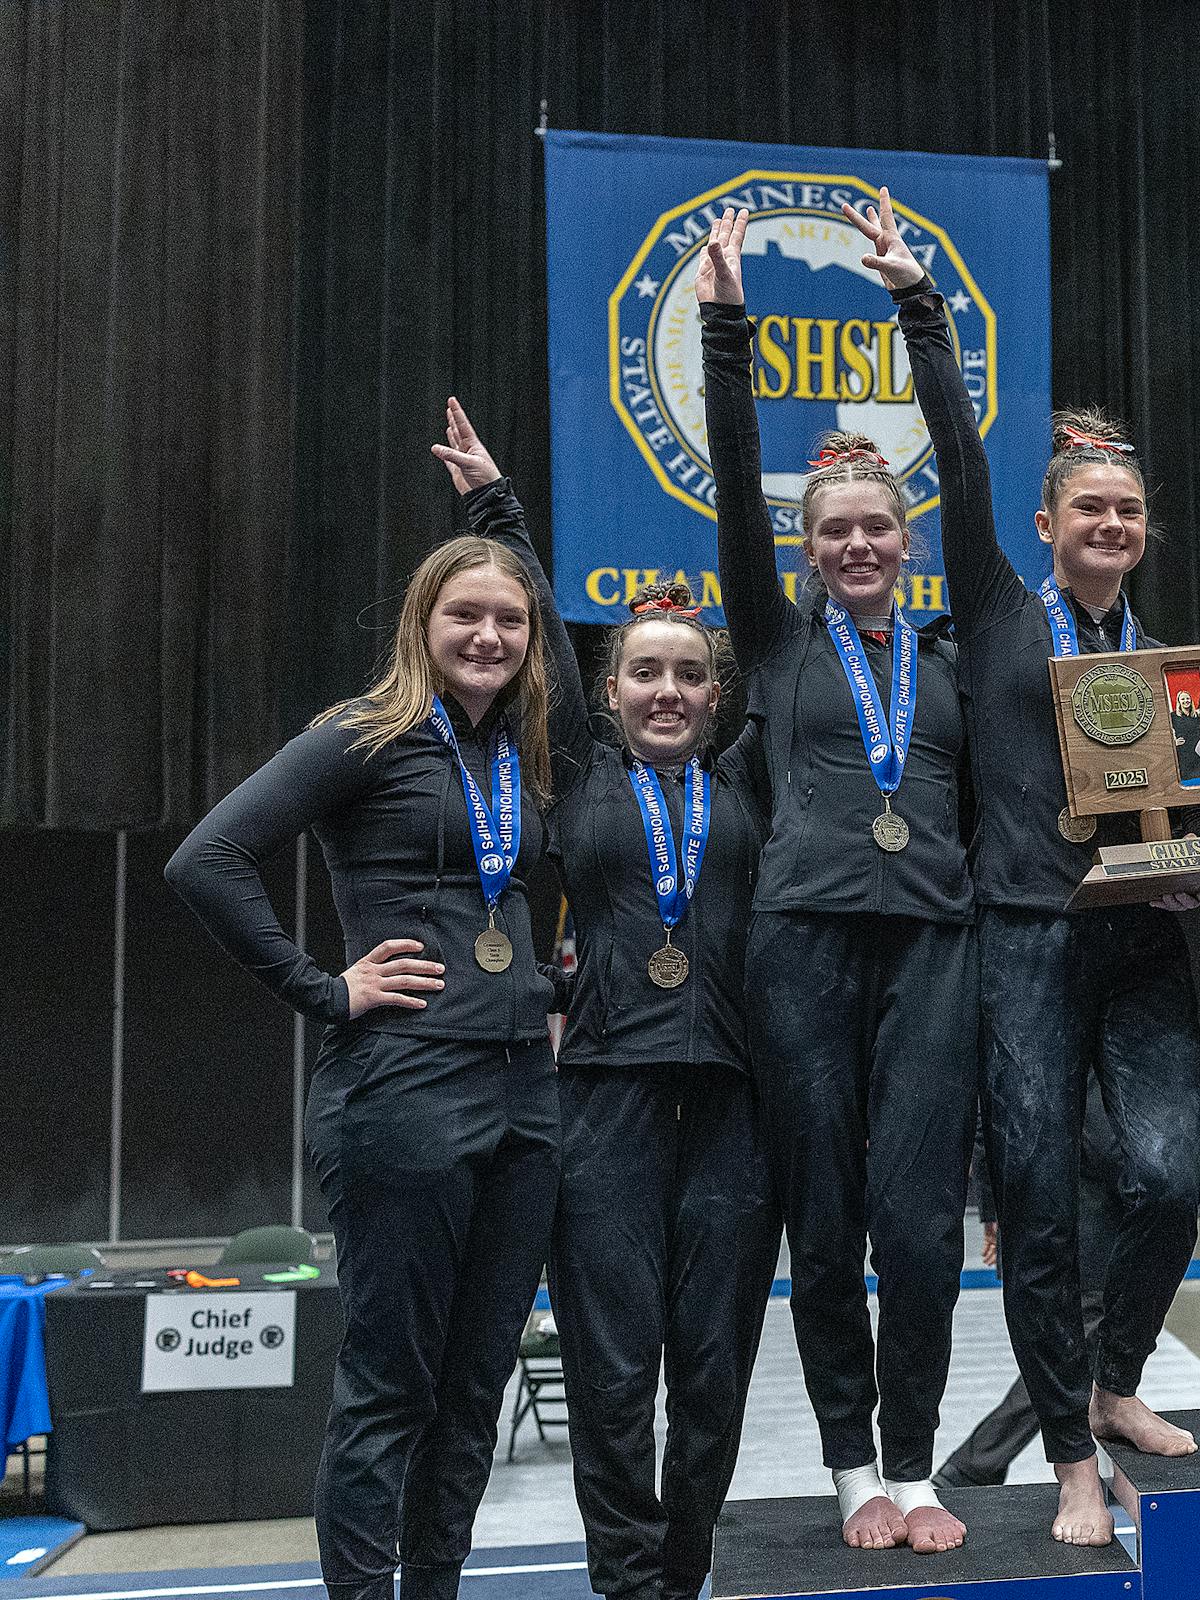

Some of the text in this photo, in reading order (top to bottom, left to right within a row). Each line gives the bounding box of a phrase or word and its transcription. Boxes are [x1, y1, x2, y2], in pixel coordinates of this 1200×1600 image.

[620, 335, 676, 451] STATE
[745, 315, 915, 403] SHSL
[1050, 606, 1069, 629] STATE
[836, 624, 882, 743] STATE CHAMPIONSHIPS
[896, 628, 911, 744] STATE CHAMPIONSHIPS
[1091, 691, 1137, 713] MSHSL
[463, 769, 494, 851] MPIONSHIPS
[499, 762, 513, 852] CHAMPIONSHIPS
[686, 768, 704, 876] STATE CHAMPIONSHIP
[1108, 772, 1144, 787] 2025
[641, 784, 670, 873] CHAMPIONSHIPS
[1150, 858, 1199, 870] STATE
[184, 1335, 253, 1360] Judge
[191, 1308, 252, 1329] Chief
